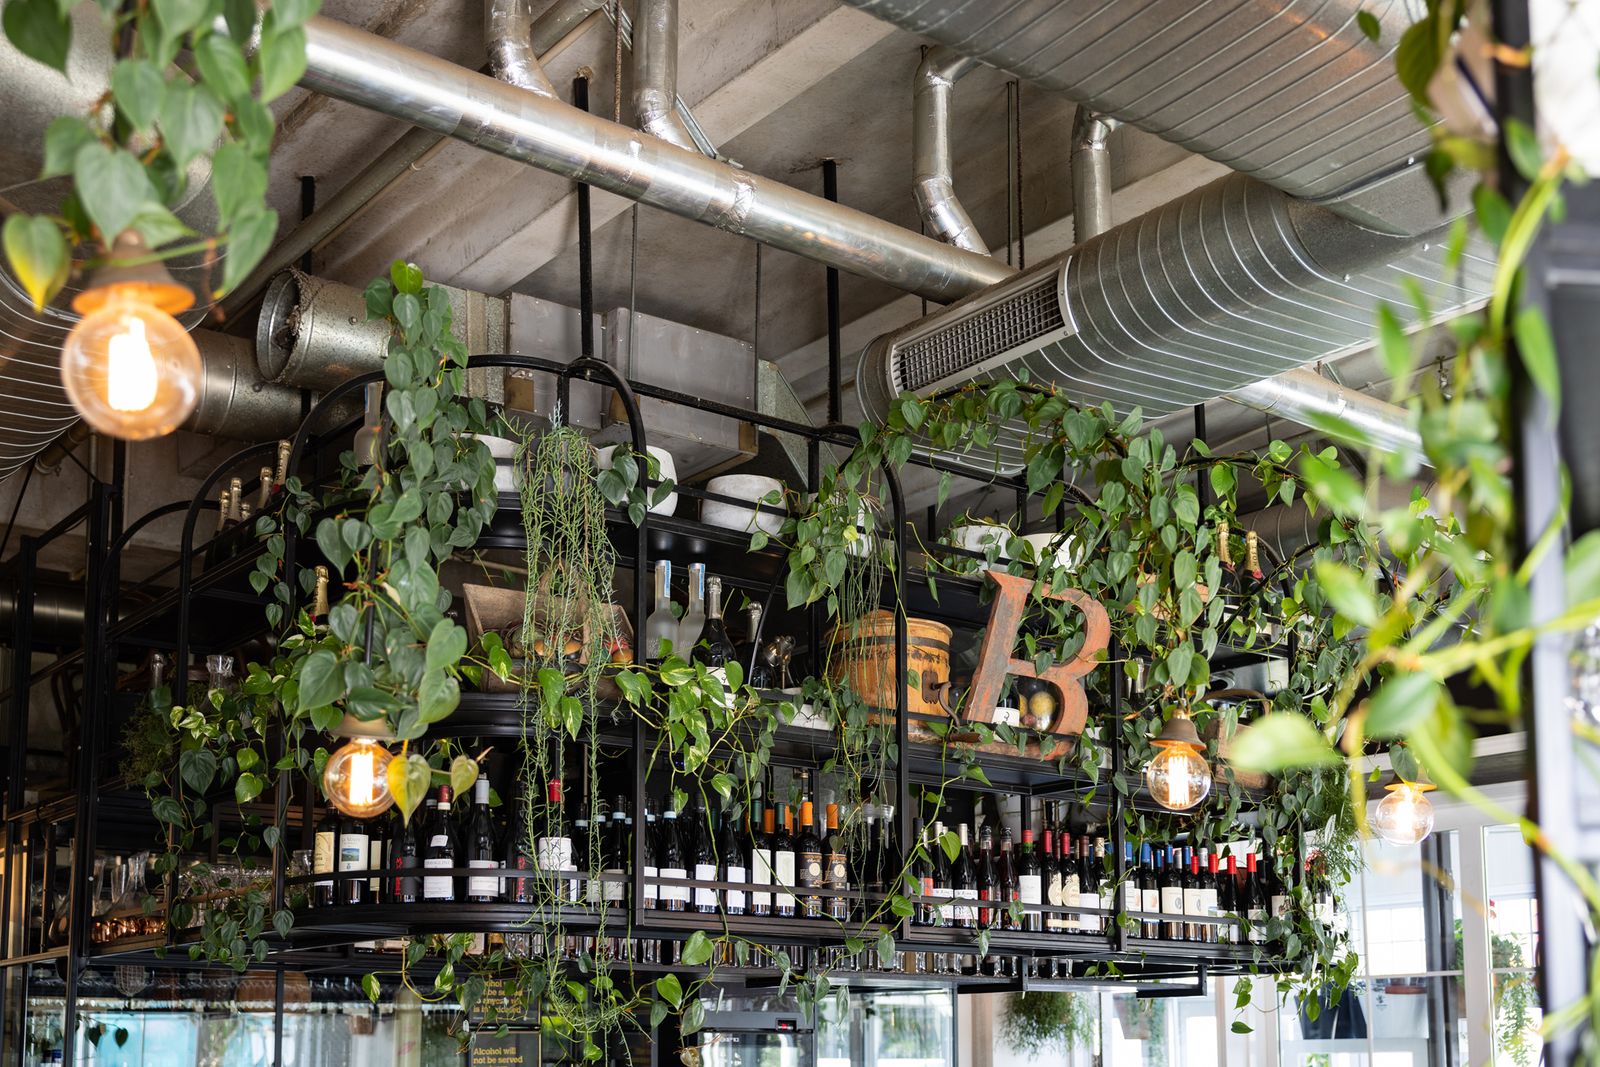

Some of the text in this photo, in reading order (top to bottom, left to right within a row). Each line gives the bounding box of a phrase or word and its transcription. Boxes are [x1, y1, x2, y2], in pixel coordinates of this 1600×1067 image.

[474, 1047, 516, 1055] Alcohol will
[473, 1056, 523, 1064] not be served
